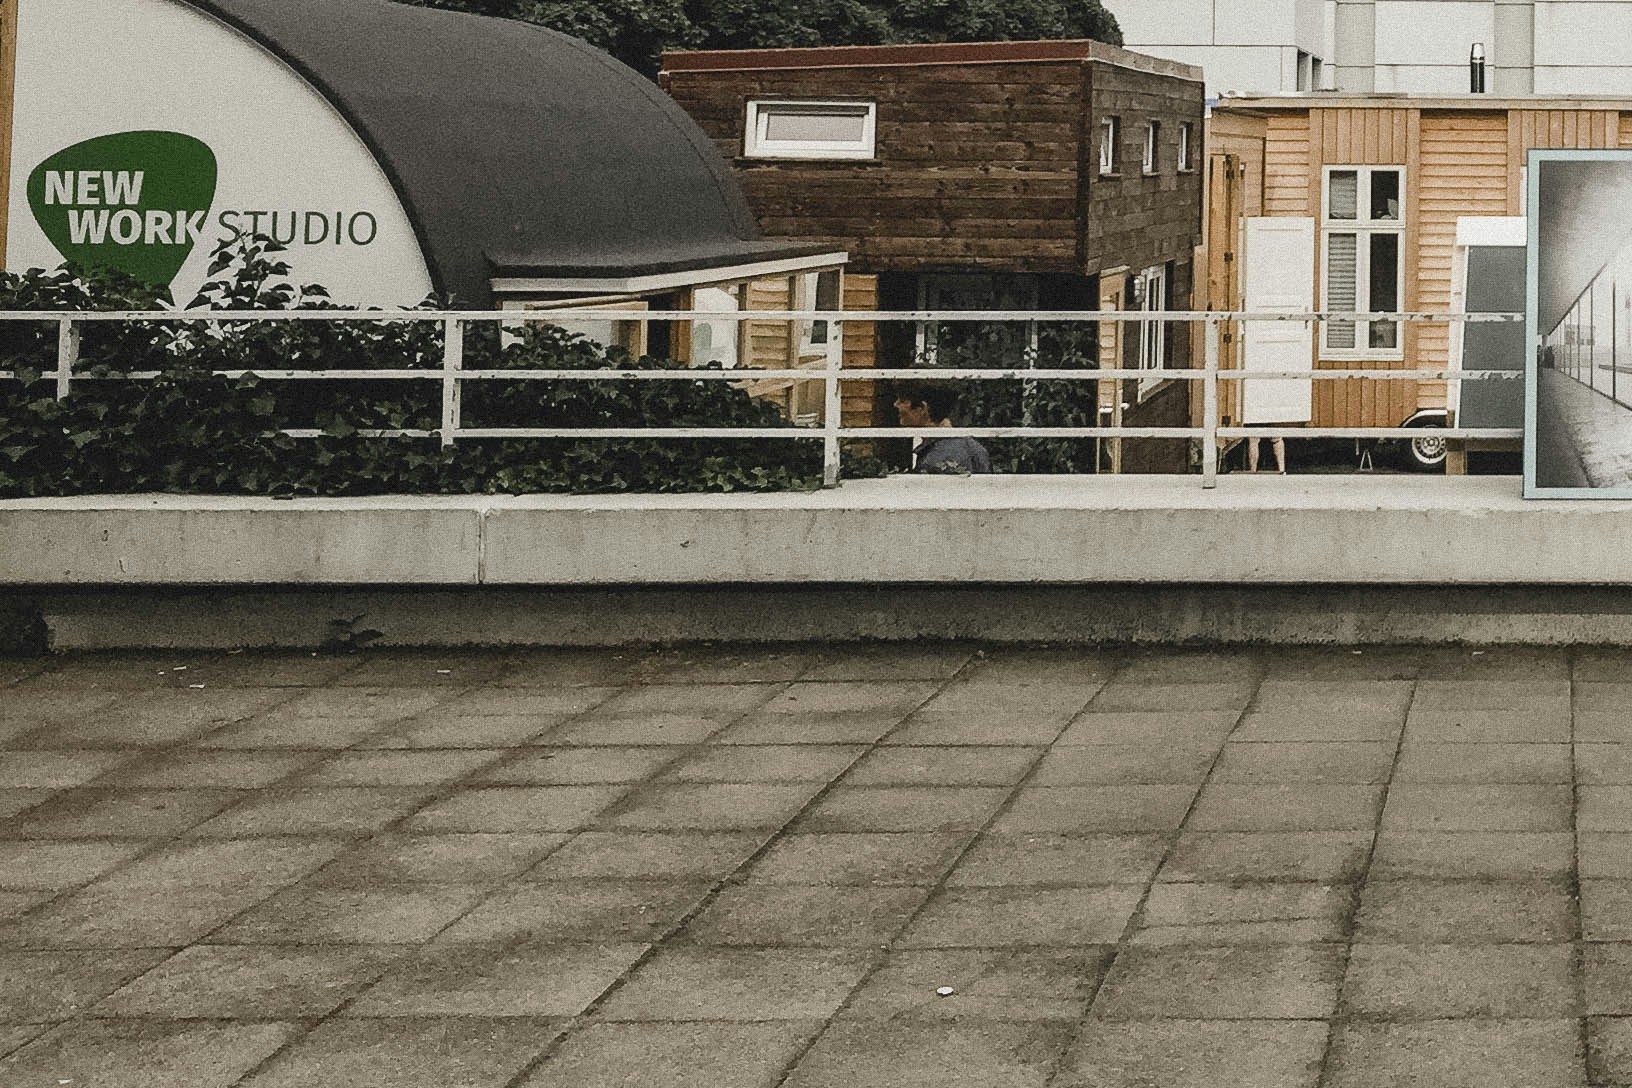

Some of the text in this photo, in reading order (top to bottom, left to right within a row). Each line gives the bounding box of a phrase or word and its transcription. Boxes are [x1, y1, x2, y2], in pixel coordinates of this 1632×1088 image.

[45, 171, 144, 204] NEW
[68, 209, 377, 245] WORK STUDIO
